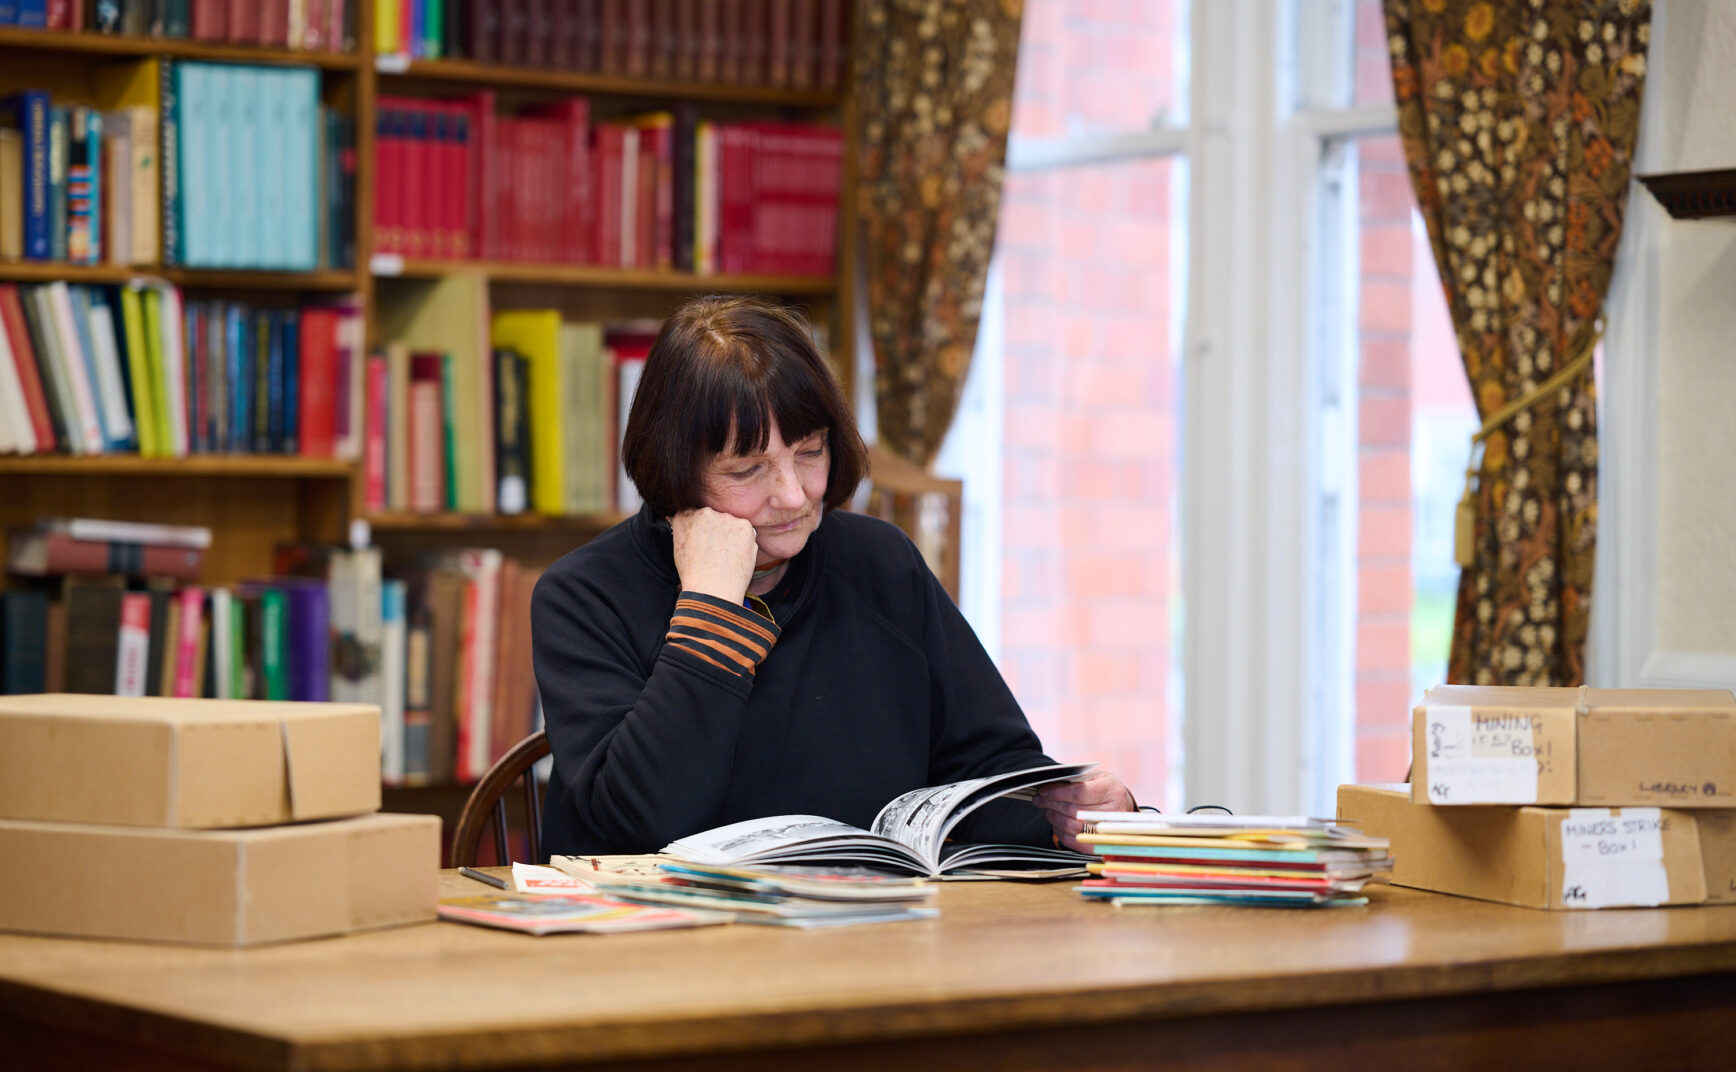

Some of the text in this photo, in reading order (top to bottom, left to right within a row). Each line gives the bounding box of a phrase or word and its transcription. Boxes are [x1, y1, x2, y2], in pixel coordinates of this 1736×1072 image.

[1475, 711, 1543, 733] MINING
[1565, 817, 1671, 837] MINERS STRIKE
